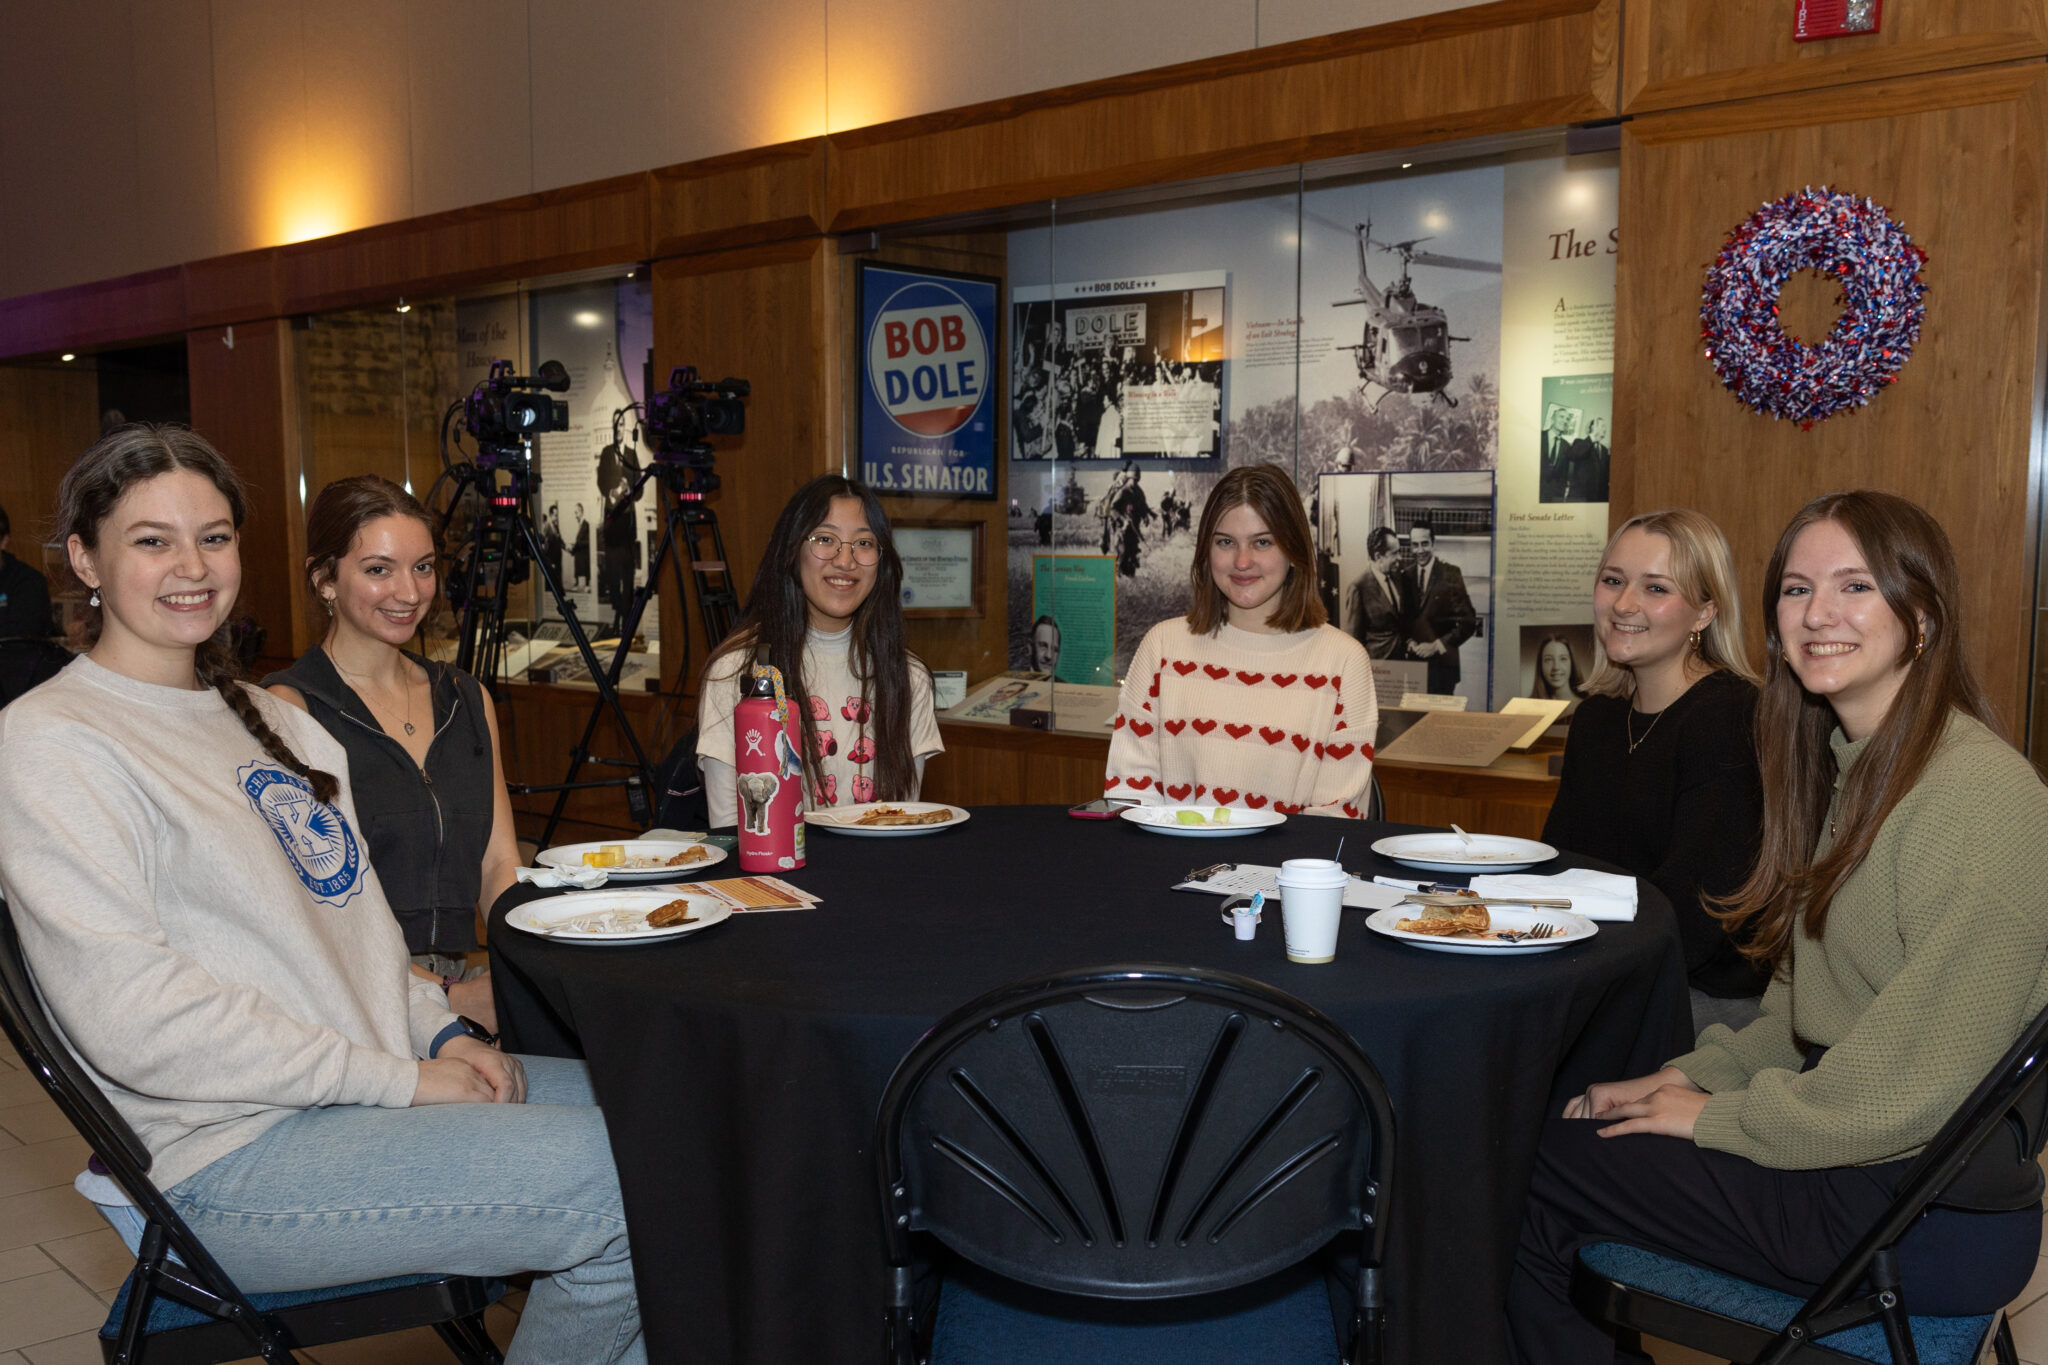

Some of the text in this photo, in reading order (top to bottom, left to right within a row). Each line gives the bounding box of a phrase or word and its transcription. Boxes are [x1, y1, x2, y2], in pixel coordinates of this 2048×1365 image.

[1549, 227, 1619, 261] The S
[1094, 280, 1136, 293] BOB DOLE
[1075, 312, 1139, 336] DOLE
[884, 315, 966, 359] BOB
[884, 360, 978, 407] DOLE
[891, 446, 965, 458] REPUBLICAN FOR
[864, 462, 988, 492] U.S. SENATOR
[1509, 512, 1575, 522] First Senate Letter
[308, 870, 352, 894] EST. 1865
